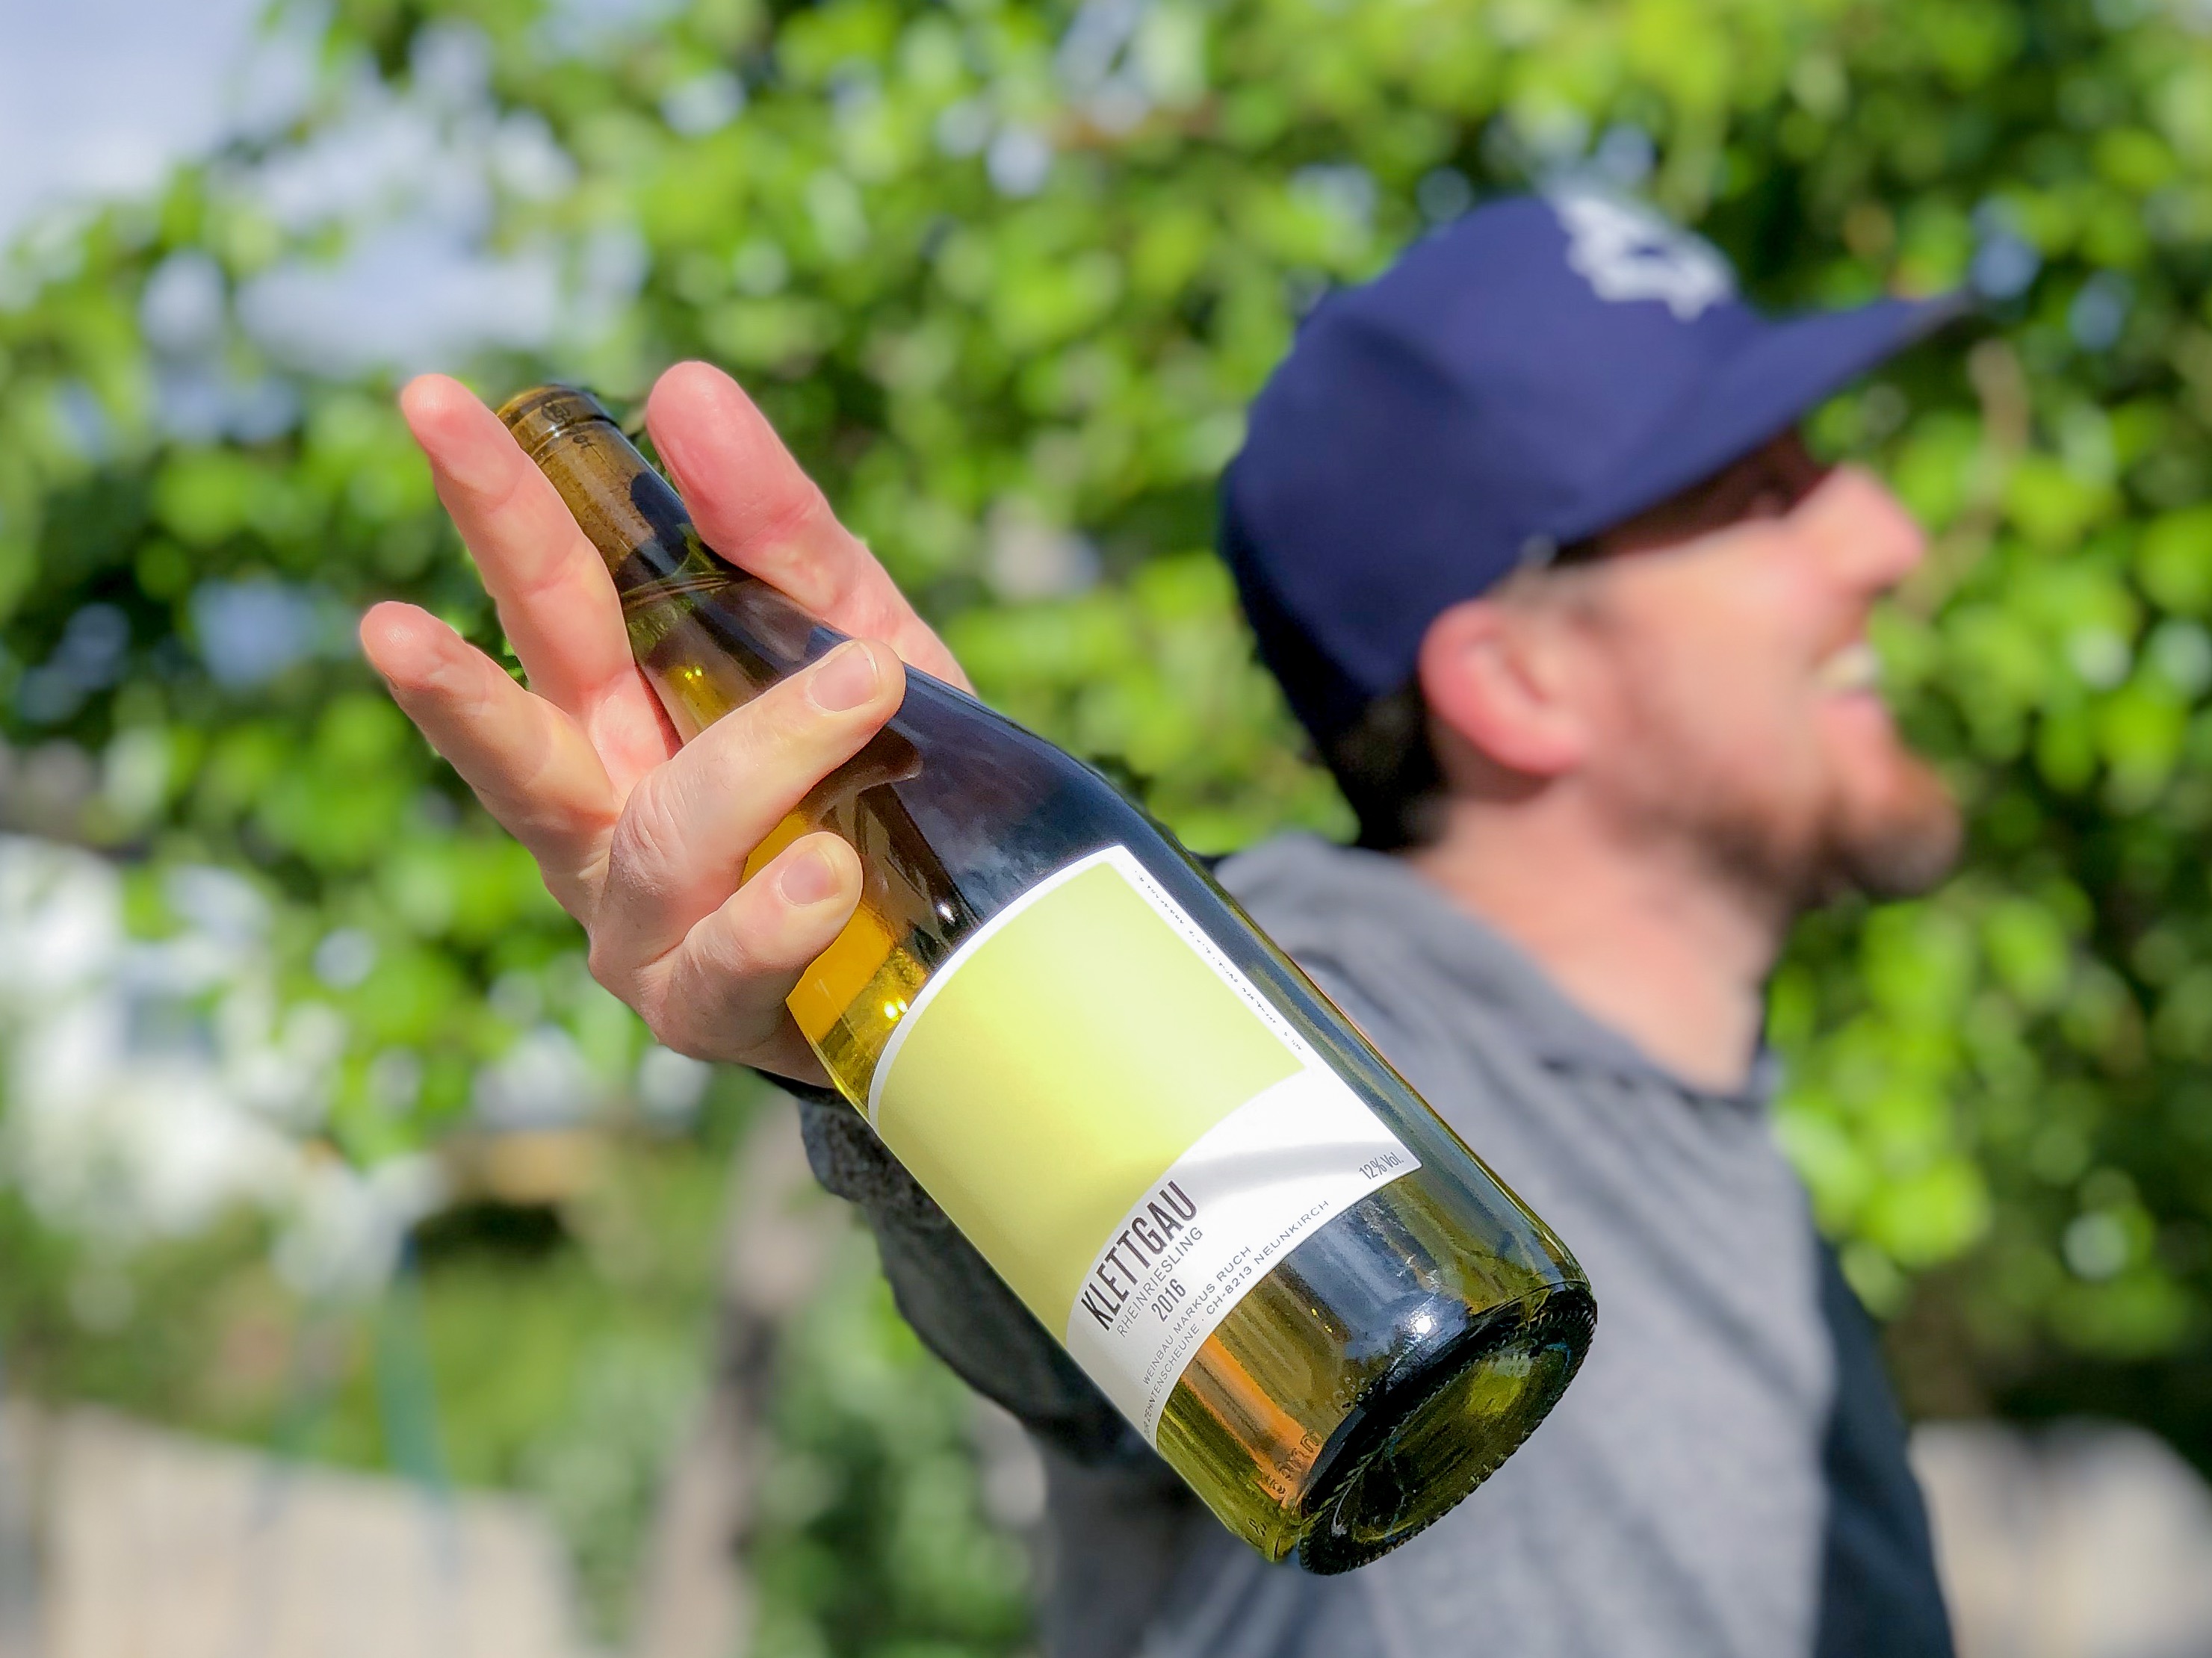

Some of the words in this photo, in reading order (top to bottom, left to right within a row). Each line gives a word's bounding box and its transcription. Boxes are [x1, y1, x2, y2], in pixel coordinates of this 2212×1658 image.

[1359, 1158, 1387, 1179] 12%
[1380, 1152, 1404, 1168] Vol.
[1081, 1179, 1197, 1332] KLETTGAU
[1254, 1200, 1329, 1265] NEUNKIRCH
[1116, 1227, 1203, 1338] RHEINRIESLING
[1142, 1335, 1174, 1385] WEINBAU
[1173, 1283, 1215, 1335] MARKUS
[1216, 1246, 1251, 1282] RUCH
[1151, 1279, 1186, 1323] 2016
